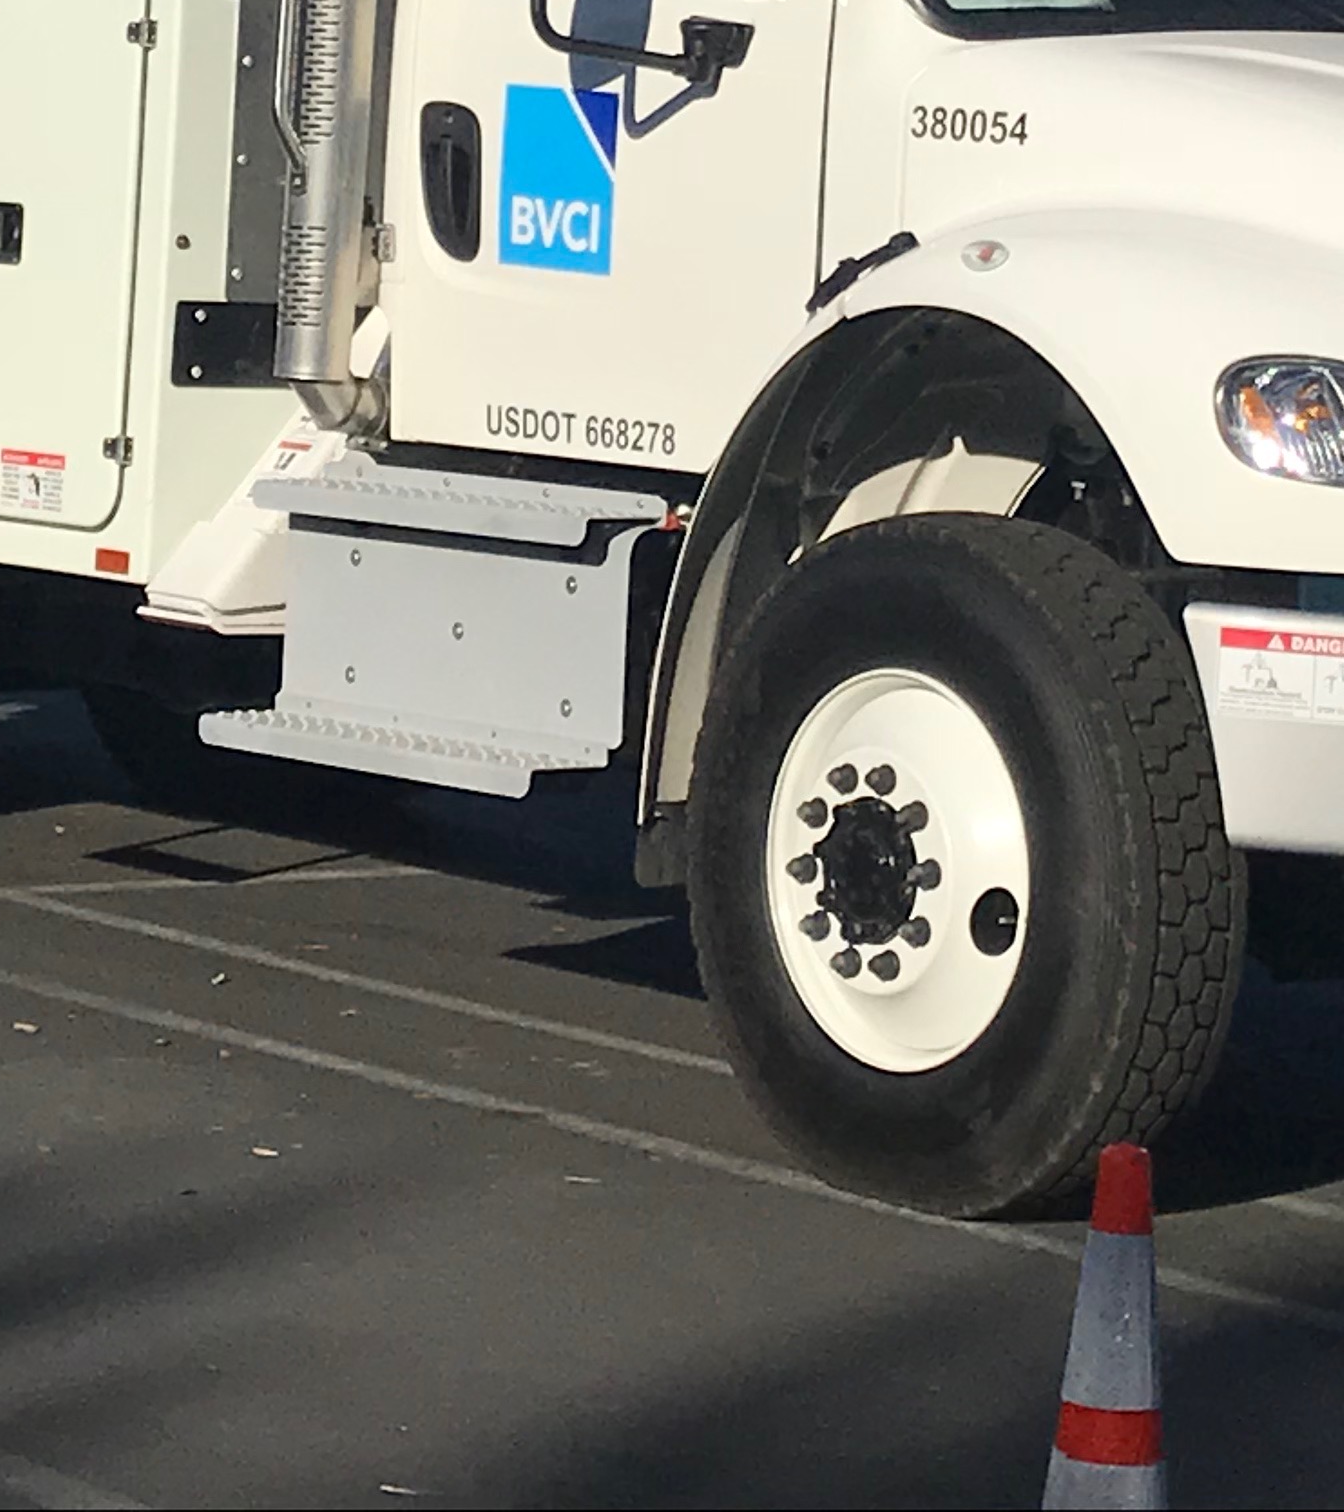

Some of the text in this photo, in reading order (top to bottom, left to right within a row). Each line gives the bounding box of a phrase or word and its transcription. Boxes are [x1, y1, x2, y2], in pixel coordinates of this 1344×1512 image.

[911, 104, 1029, 145] 380054
[510, 194, 600, 254] BVCI
[486, 404, 676, 455] USDOT 668278
